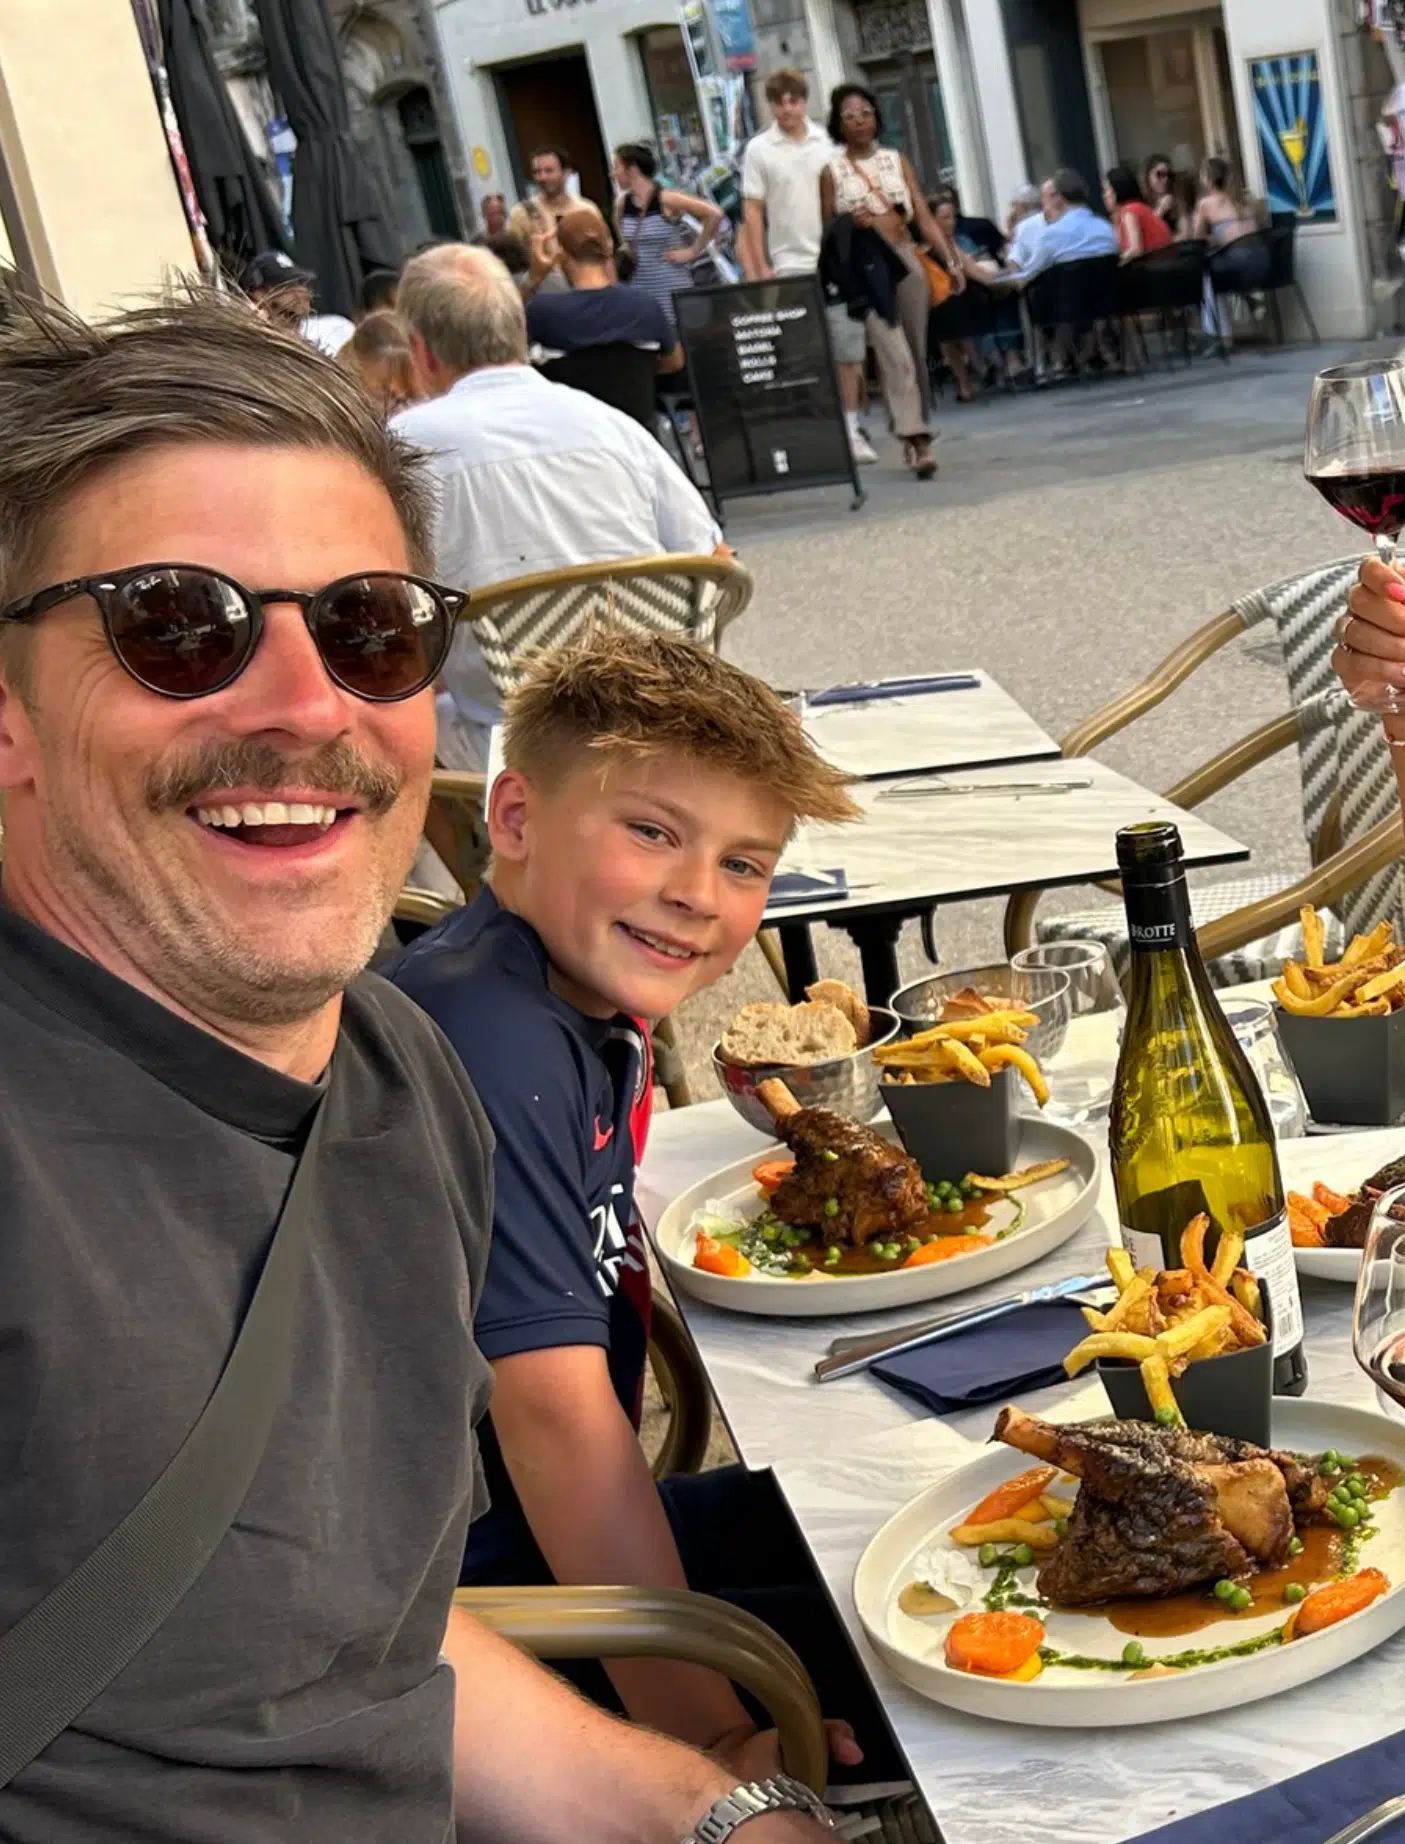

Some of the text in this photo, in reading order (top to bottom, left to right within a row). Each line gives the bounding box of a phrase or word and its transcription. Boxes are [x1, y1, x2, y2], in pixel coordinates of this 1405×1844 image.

[731, 307, 807, 328] COFFEE SHOP
[1131, 923, 1176, 939] BROTTE
